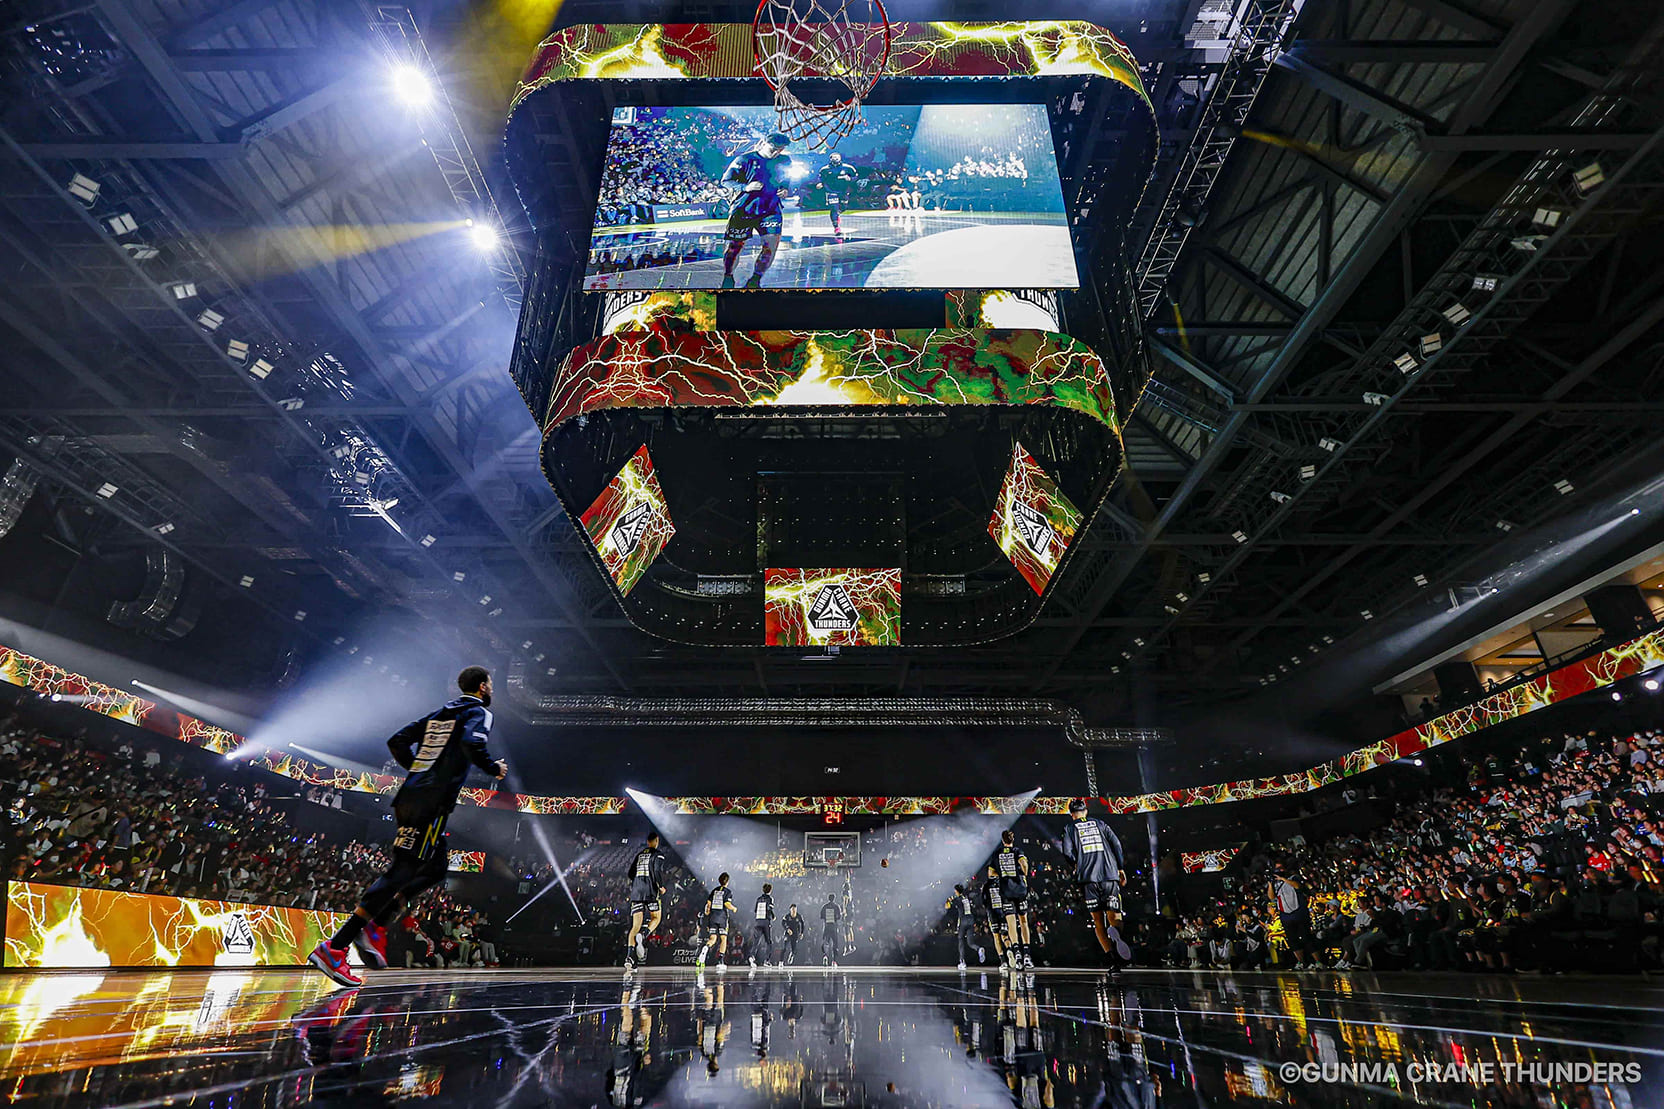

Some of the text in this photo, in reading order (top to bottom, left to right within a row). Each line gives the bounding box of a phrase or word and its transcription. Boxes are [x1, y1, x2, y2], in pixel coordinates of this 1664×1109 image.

[669, 208, 705, 217] SoftBank
[813, 587, 833, 614] GUNMA
[833, 587, 853, 614] CRANE
[815, 619, 851, 628] THUNDERS
[825, 812, 840, 823] 24
